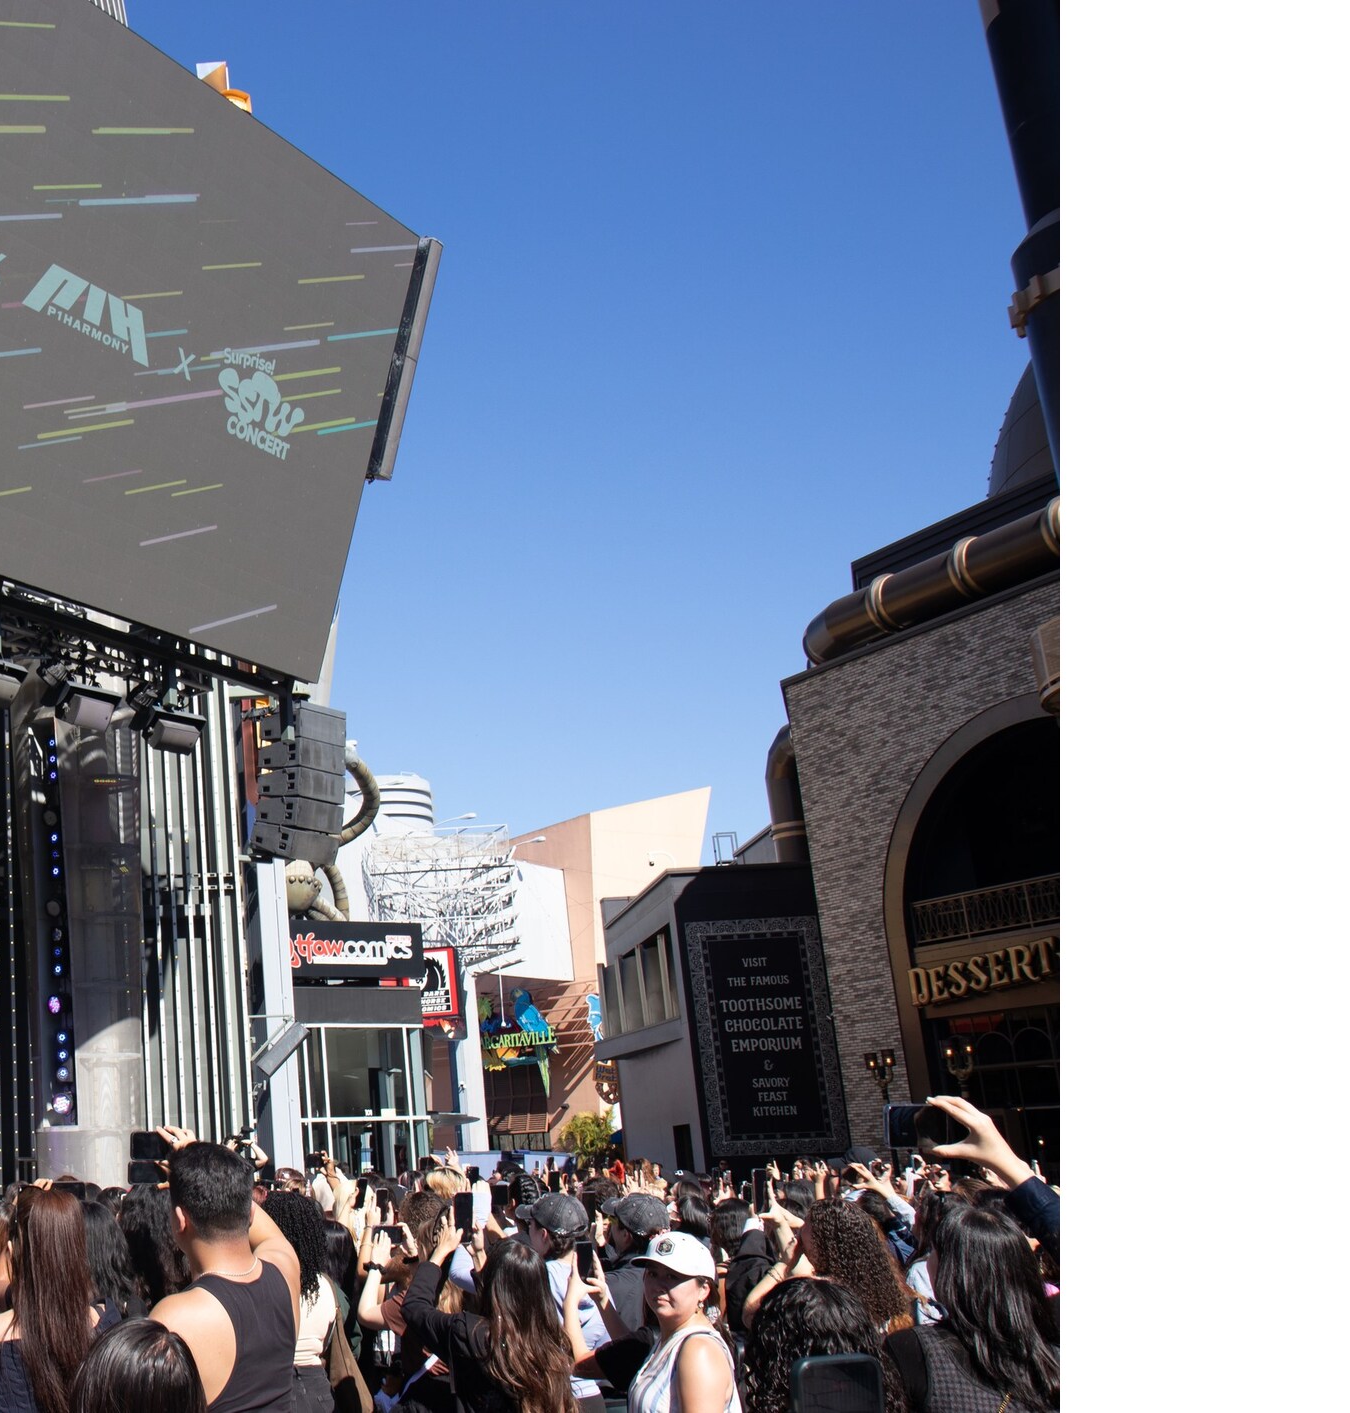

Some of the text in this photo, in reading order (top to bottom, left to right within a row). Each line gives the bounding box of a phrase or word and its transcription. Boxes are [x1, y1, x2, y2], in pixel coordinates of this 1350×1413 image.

[46, 305, 130, 354] P1HARMONY
[224, 347, 276, 376] Surprise!
[227, 415, 290, 461] CONCERT
[741, 957, 767, 968] VISIT
[907, 936, 1059, 1007] DESSERT
[727, 975, 790, 987] THE FAMOUS
[719, 996, 803, 1013] TOOTHSOME
[724, 1016, 804, 1033] CHOCOLATE
[480, 1025, 557, 1050] ARGARITAVILLE
[731, 1037, 802, 1053] EMPORIUM
[763, 1059, 774, 1071] &
[752, 1077, 791, 1088] SAVORY
[758, 1091, 788, 1102] FEAST
[752, 1105, 798, 1117] KITCHEN
